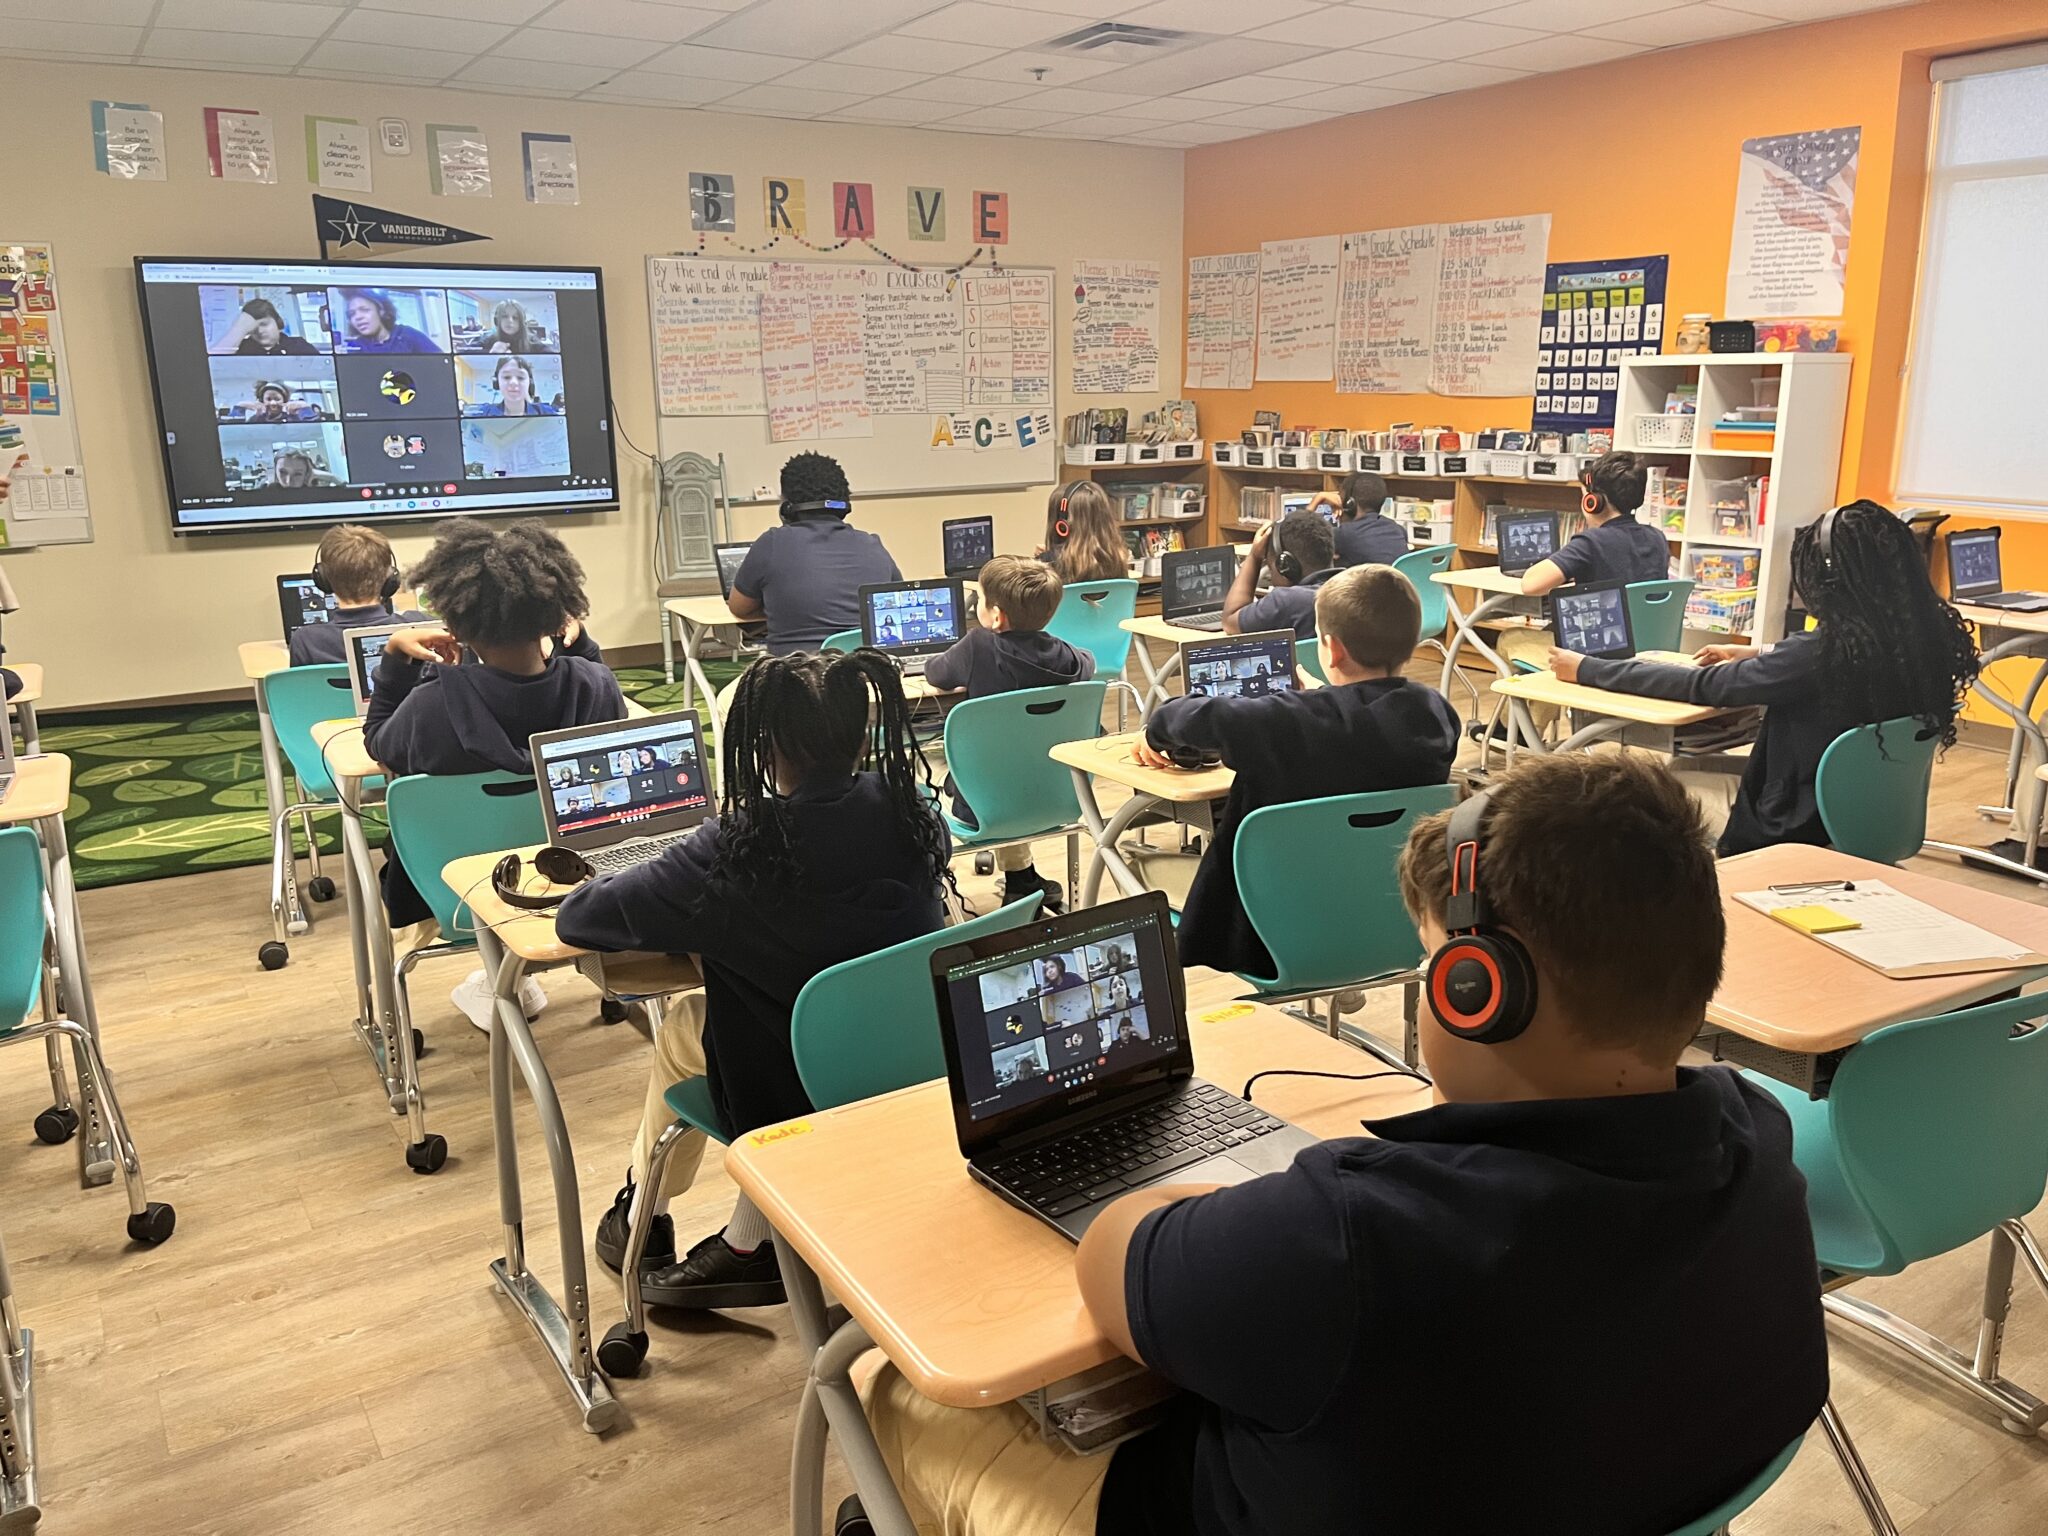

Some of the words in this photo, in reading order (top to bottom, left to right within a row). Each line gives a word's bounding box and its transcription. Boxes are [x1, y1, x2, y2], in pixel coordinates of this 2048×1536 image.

[329, 141, 358, 152] Always
[326, 151, 348, 160] clean
[539, 171, 563, 180] Follow
[537, 180, 575, 189] directions
[345, 223, 359, 240] V
[381, 223, 448, 238] VANDERBILT
[1449, 223, 1487, 238] Wednesday
[1370, 232, 1395, 255] Grade
[1400, 228, 1435, 252] Schedule
[1192, 257, 1212, 272] TEXT
[1458, 256, 1488, 269] SWITCH
[0, 264, 22, 275] obs
[653, 260, 667, 281] By
[675, 261, 695, 279] the
[701, 263, 720, 281] end
[726, 264, 736, 281] of
[740, 266, 769, 282] module
[1471, 268, 1482, 278] ELA
[862, 272, 878, 288] NO
[1370, 276, 1396, 291] SWITCH
[1590, 276, 1606, 285] May
[706, 282, 717, 294] be
[722, 283, 740, 293] able
[965, 281, 975, 302] E
[921, 294, 931, 302] the
[933, 293, 944, 302] end
[968, 307, 976, 325] S
[1594, 329, 1602, 338] 10
[1611, 329, 1618, 337] 11
[1627, 328, 1635, 336] 12
[1648, 326, 1656, 335] 13
[968, 331, 976, 348] C
[1541, 354, 1548, 362] 14
[1558, 354, 1566, 362] 15
[1574, 353, 1583, 362] 16
[1591, 353, 1599, 362] 17
[1609, 353, 1618, 362] 18
[969, 355, 977, 373] A
[969, 377, 976, 392] P
[1539, 377, 1548, 386] 21
[1555, 377, 1565, 386] 22
[1571, 377, 1581, 386] 23
[1589, 377, 1599, 386] 24
[1605, 377, 1615, 386] 25
[1539, 400, 1548, 408] 28
[1554, 400, 1564, 408] 29
[1571, 401, 1580, 409] 30
[1586, 401, 1595, 409] 31
[931, 415, 954, 446] A
[975, 417, 992, 448] C
[1015, 415, 1036, 448] E
